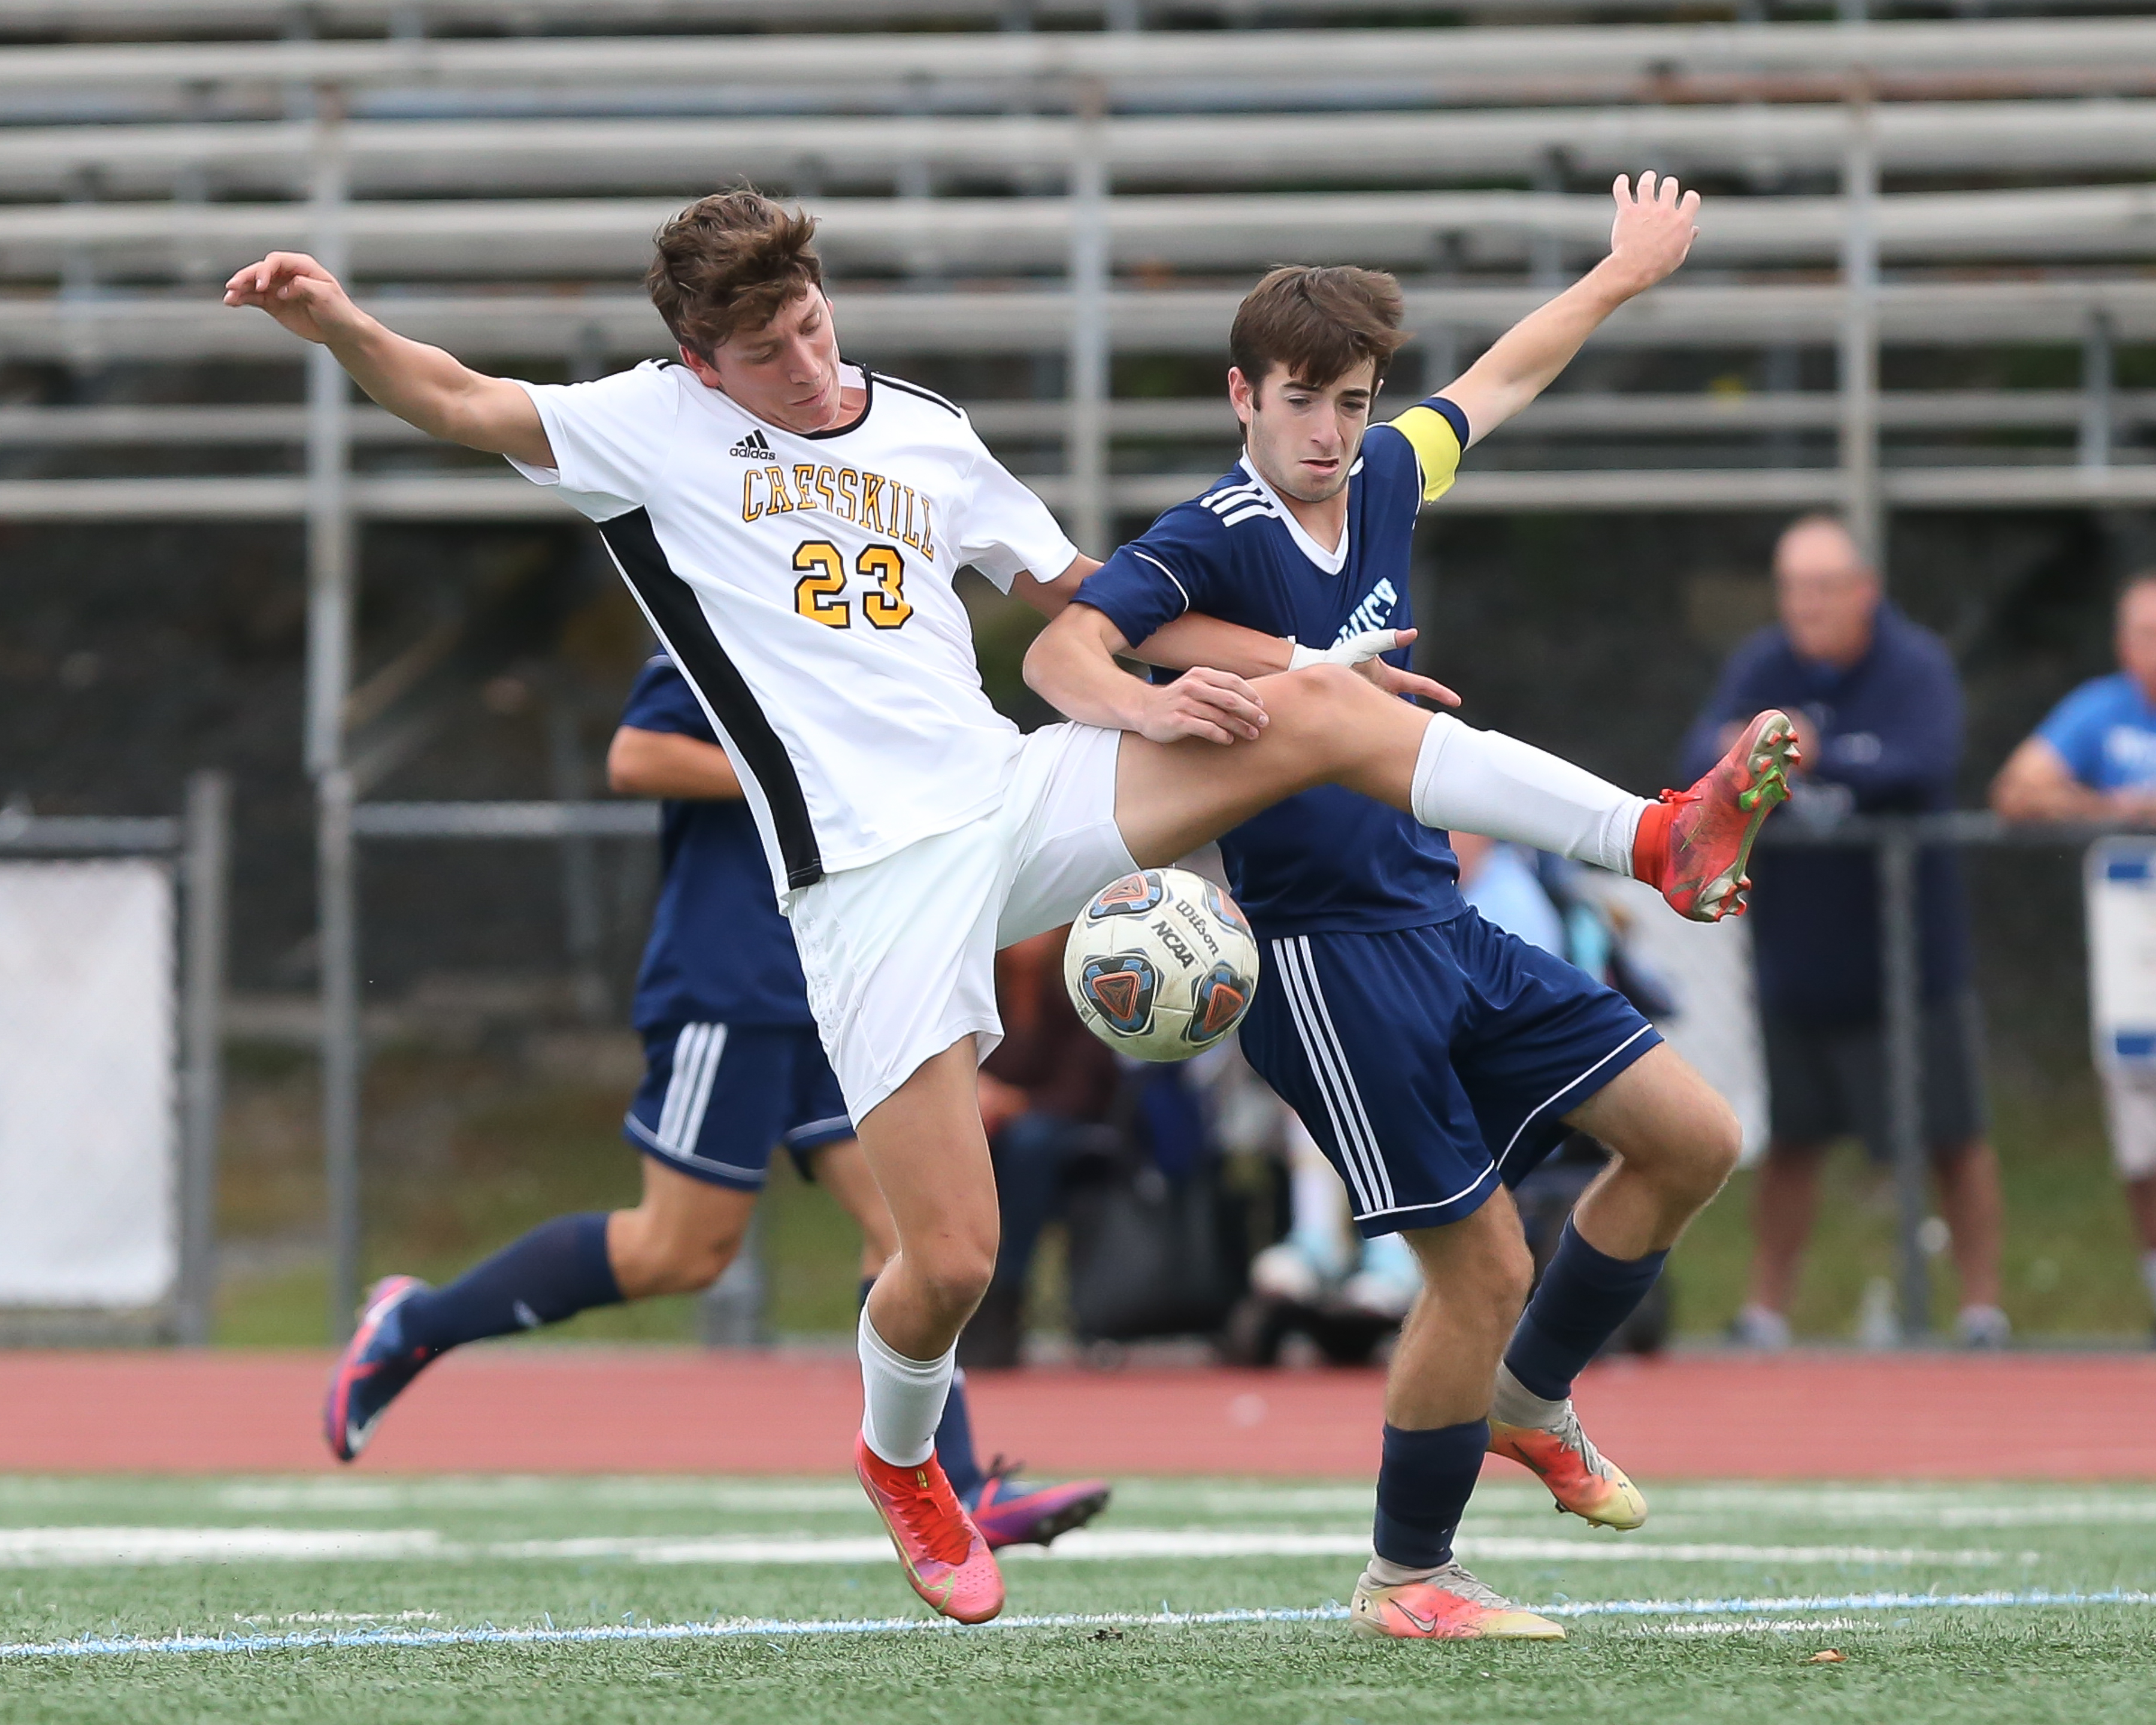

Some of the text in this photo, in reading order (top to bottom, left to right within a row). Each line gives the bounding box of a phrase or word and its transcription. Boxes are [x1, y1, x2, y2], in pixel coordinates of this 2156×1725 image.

[729, 446, 776, 461] adidas
[742, 464, 936, 562] CRESSKILL
[792, 540, 914, 630] 23
[1151, 920, 1194, 970] NCAA
[1175, 899, 1221, 958] Wilson
